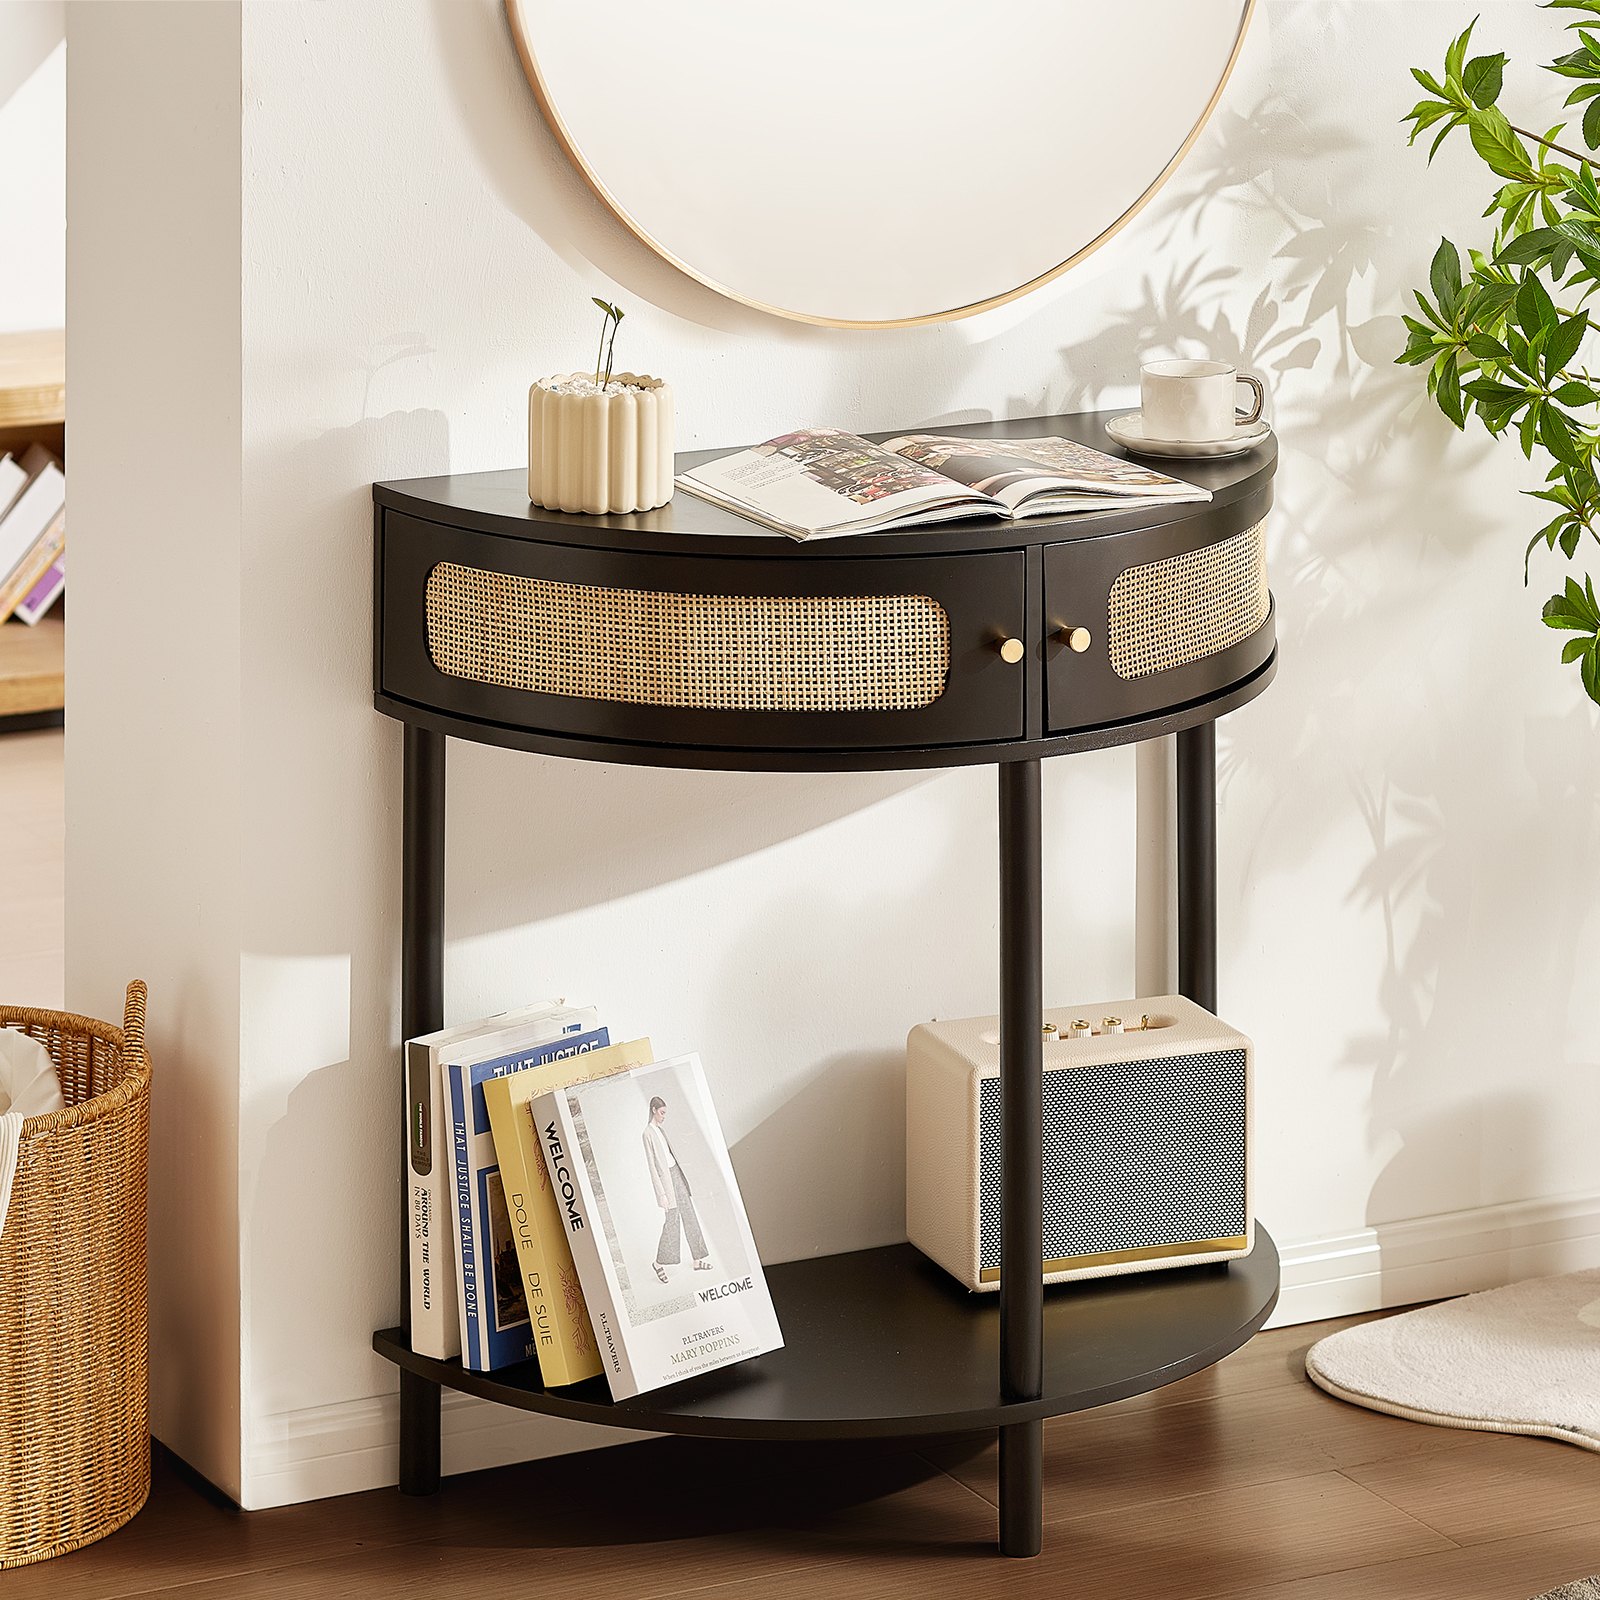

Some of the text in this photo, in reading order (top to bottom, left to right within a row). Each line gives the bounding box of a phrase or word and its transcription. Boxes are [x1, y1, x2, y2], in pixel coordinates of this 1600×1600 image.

[414, 1186, 420, 1197] IN
[414, 1200, 420, 1211] 80
[544, 1120, 585, 1232] WELCOME
[421, 1188, 431, 1311] AROUND THE WORLD
[455, 1122, 477, 1318] THAT JUSTICE SHALL BE DONE
[512, 1193, 553, 1346] DOUE DE SUIE
[698, 1277, 753, 1303] WELCOME
[670, 1334, 740, 1365] MARY POPPINS
